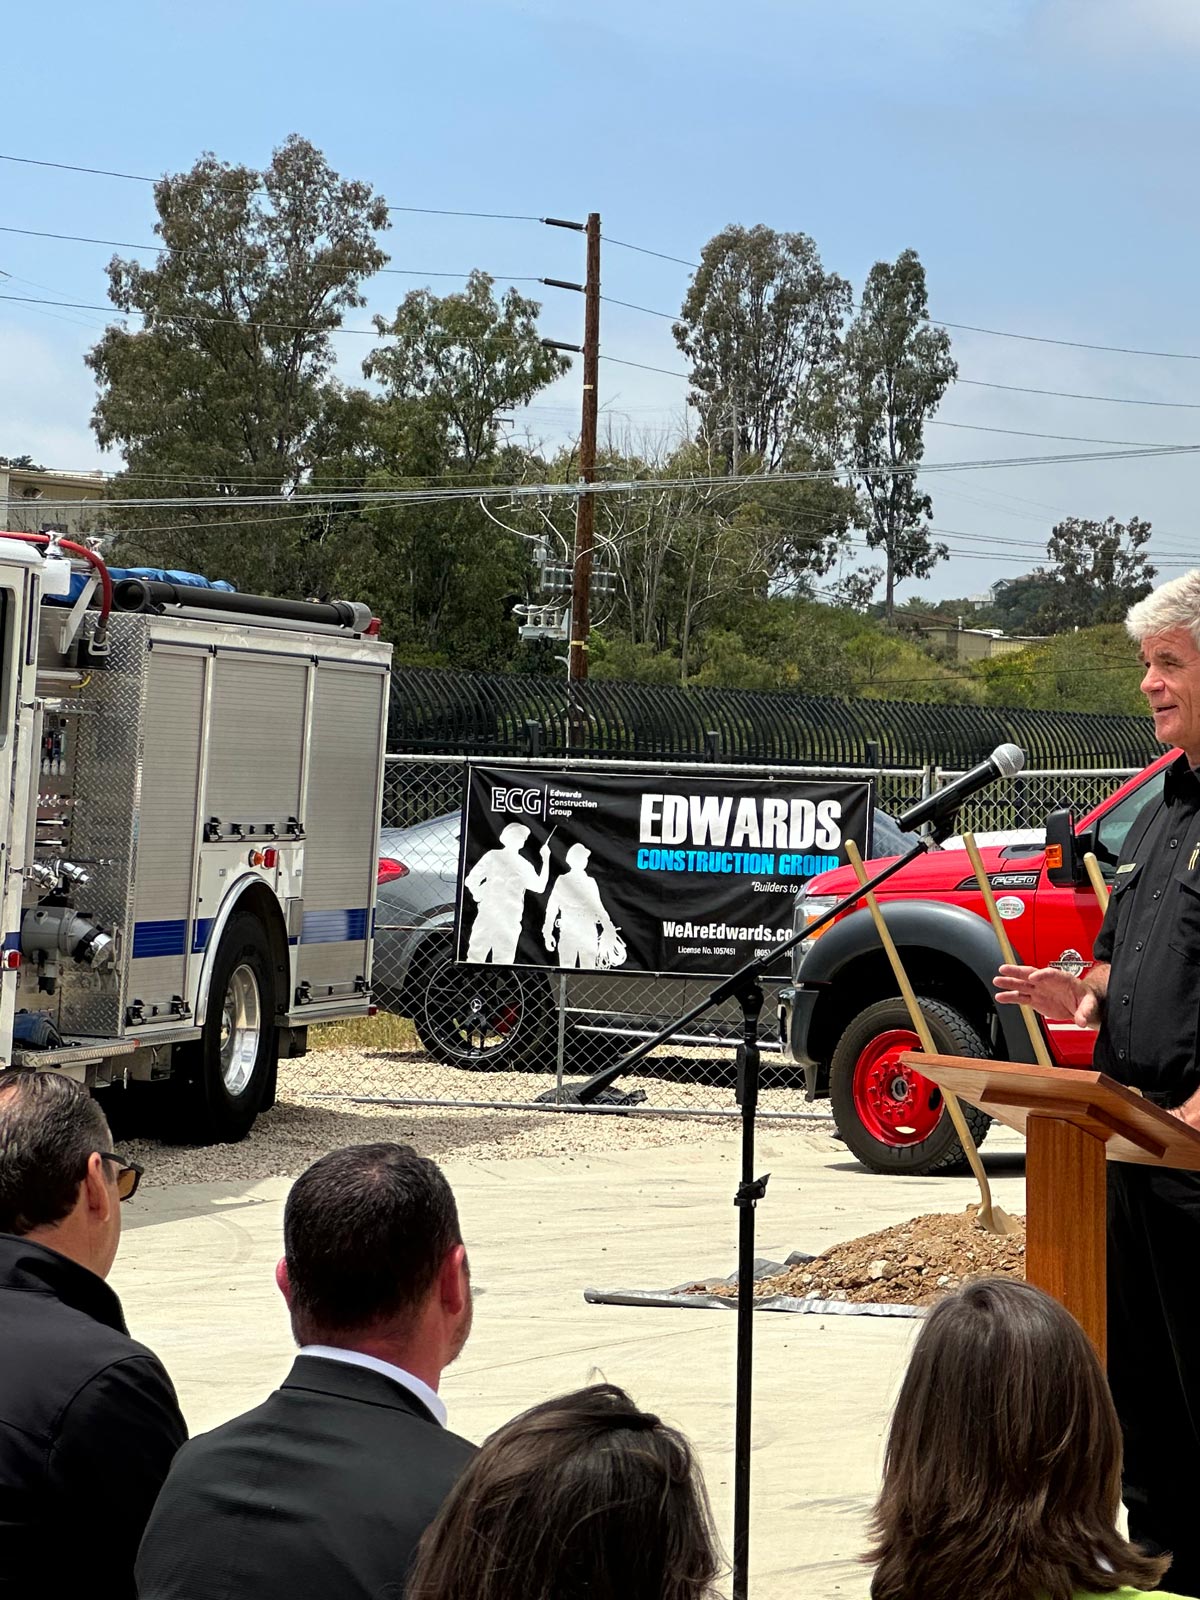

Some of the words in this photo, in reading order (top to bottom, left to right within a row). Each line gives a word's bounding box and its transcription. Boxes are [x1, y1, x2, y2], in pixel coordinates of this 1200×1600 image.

[549, 789, 582, 799] Edwards
[491, 787, 541, 814] ECG
[549, 798, 598, 808] Construction
[549, 807, 573, 818] Group
[639, 794, 842, 850] EDWARDS
[637, 849, 775, 875] CONSTRUCTION
[778, 854, 840, 877] GROUP
[789, 883, 799, 894] to
[663, 921, 793, 942] WeAreEdwards.co
[677, 946, 701, 955] License
[702, 946, 713, 955] No.
[713, 946, 736, 956] 1057451
